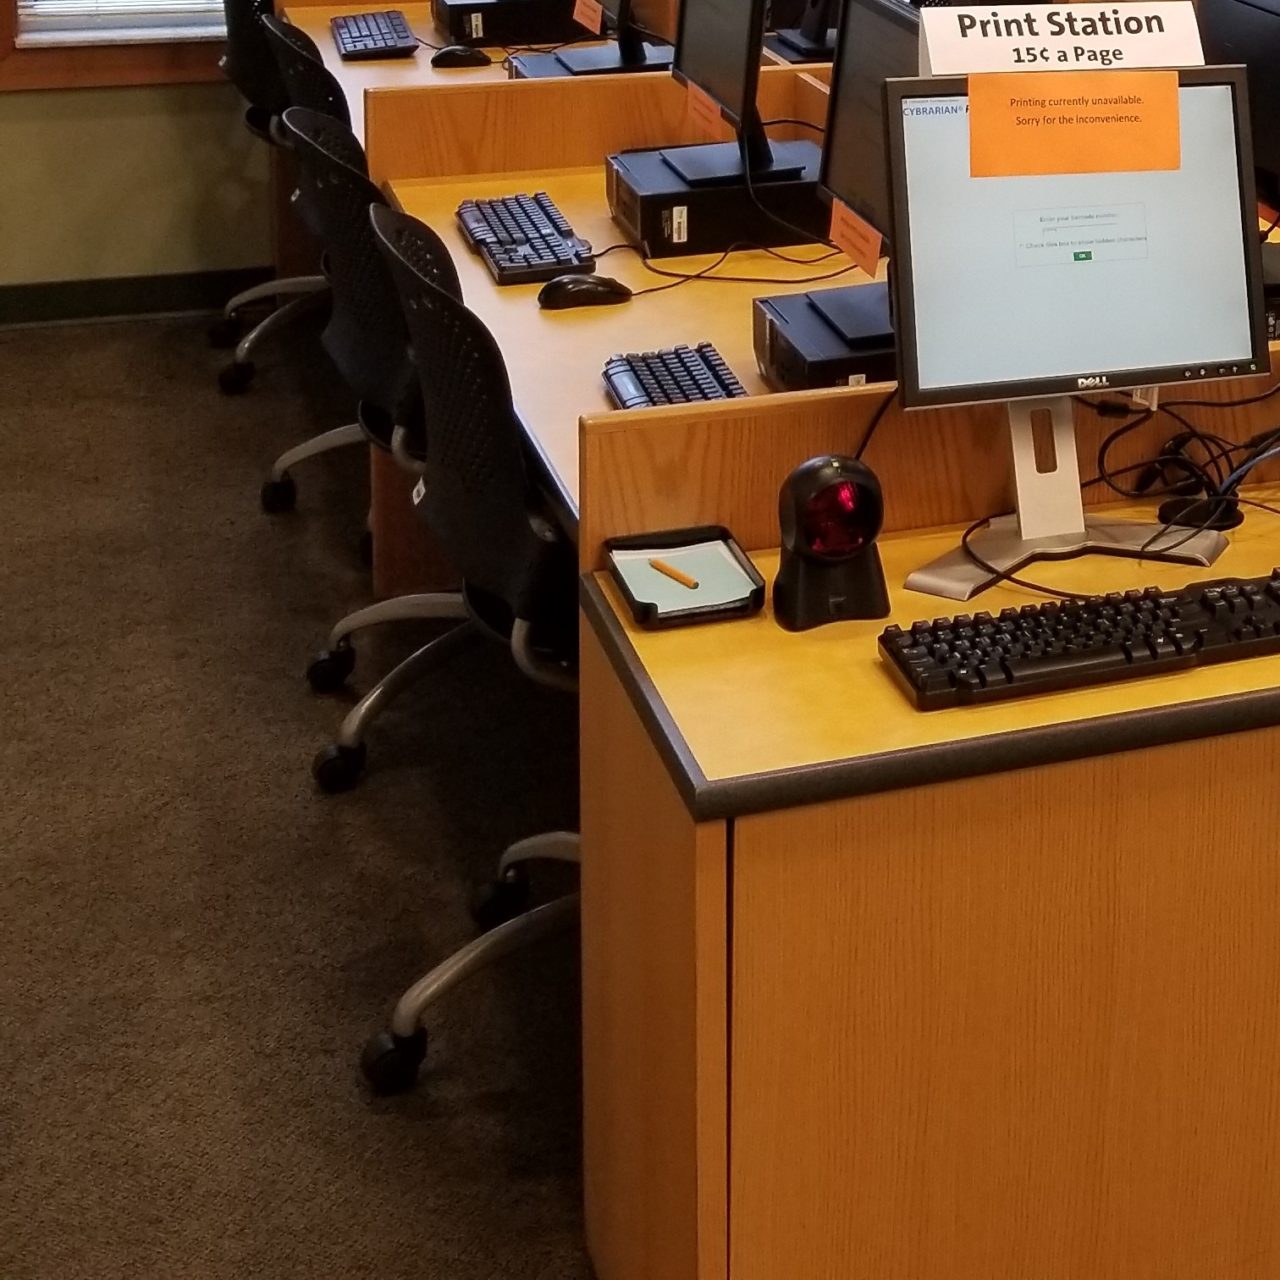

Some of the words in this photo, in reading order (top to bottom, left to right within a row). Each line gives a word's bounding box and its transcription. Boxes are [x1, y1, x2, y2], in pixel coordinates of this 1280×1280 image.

[957, 11, 1040, 39] Print
[1046, 8, 1165, 37] Station
[1012, 47, 1050, 64] 15¢
[1057, 50, 1068, 62] a
[1073, 45, 1124, 66] Page
[1009, 97, 1047, 108] Printing
[1048, 96, 1090, 108] currently
[1091, 95, 1145, 106] unavailable.
[1015, 116, 1041, 127] Sorry
[1042, 115, 1056, 125] for
[1058, 114, 1074, 125] the
[1075, 113, 1143, 124] inconvenience.
[1077, 375, 1110, 389] DELL
